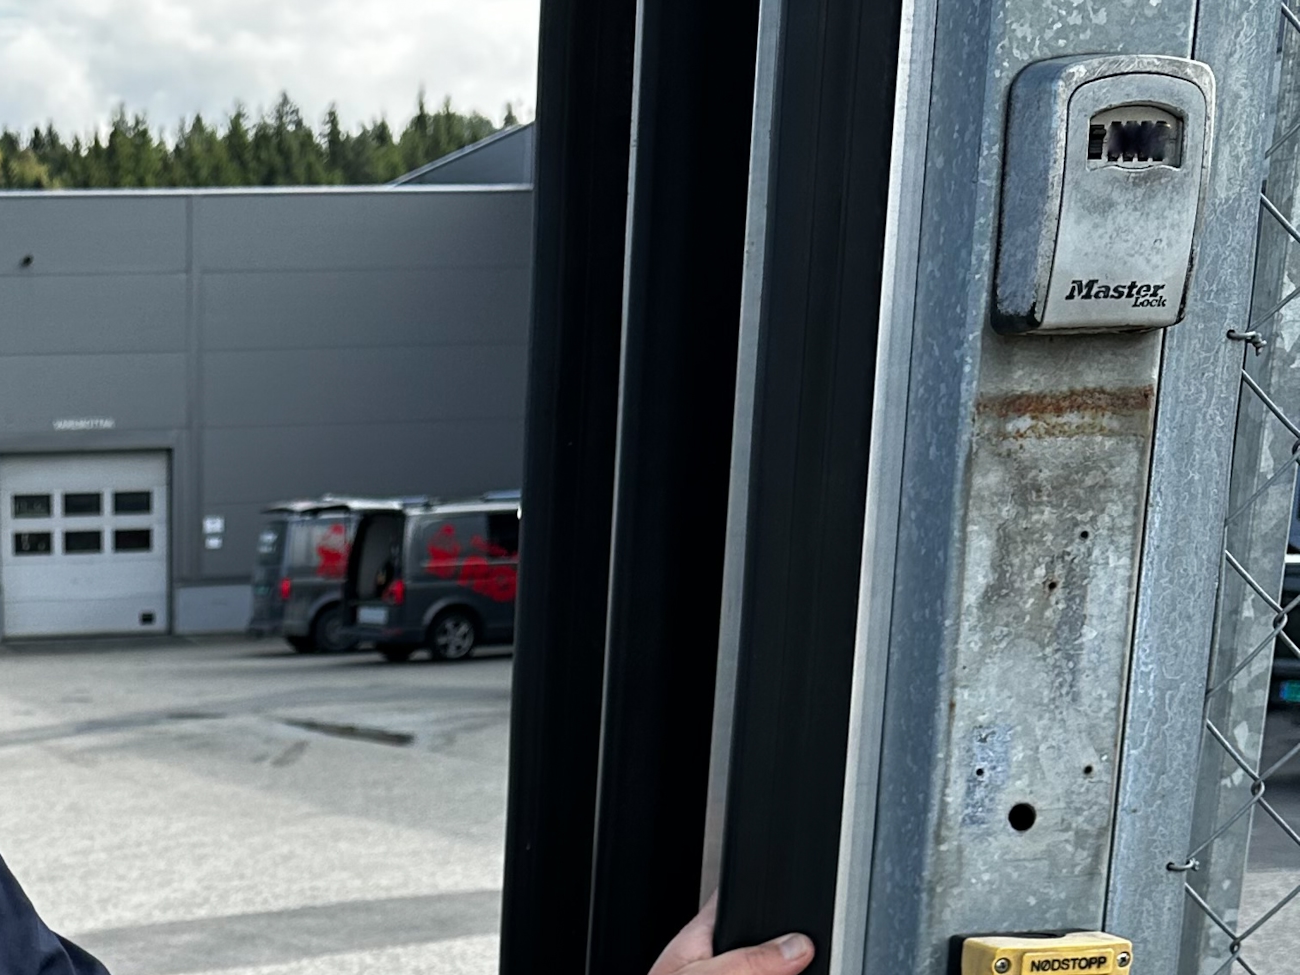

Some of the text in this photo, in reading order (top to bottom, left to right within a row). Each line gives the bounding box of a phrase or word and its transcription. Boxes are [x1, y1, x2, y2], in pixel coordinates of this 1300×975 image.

[1065, 279, 1165, 301] Master
[1132, 295, 1167, 308] Lock
[1030, 956, 1107, 972] NØDSTOPP
